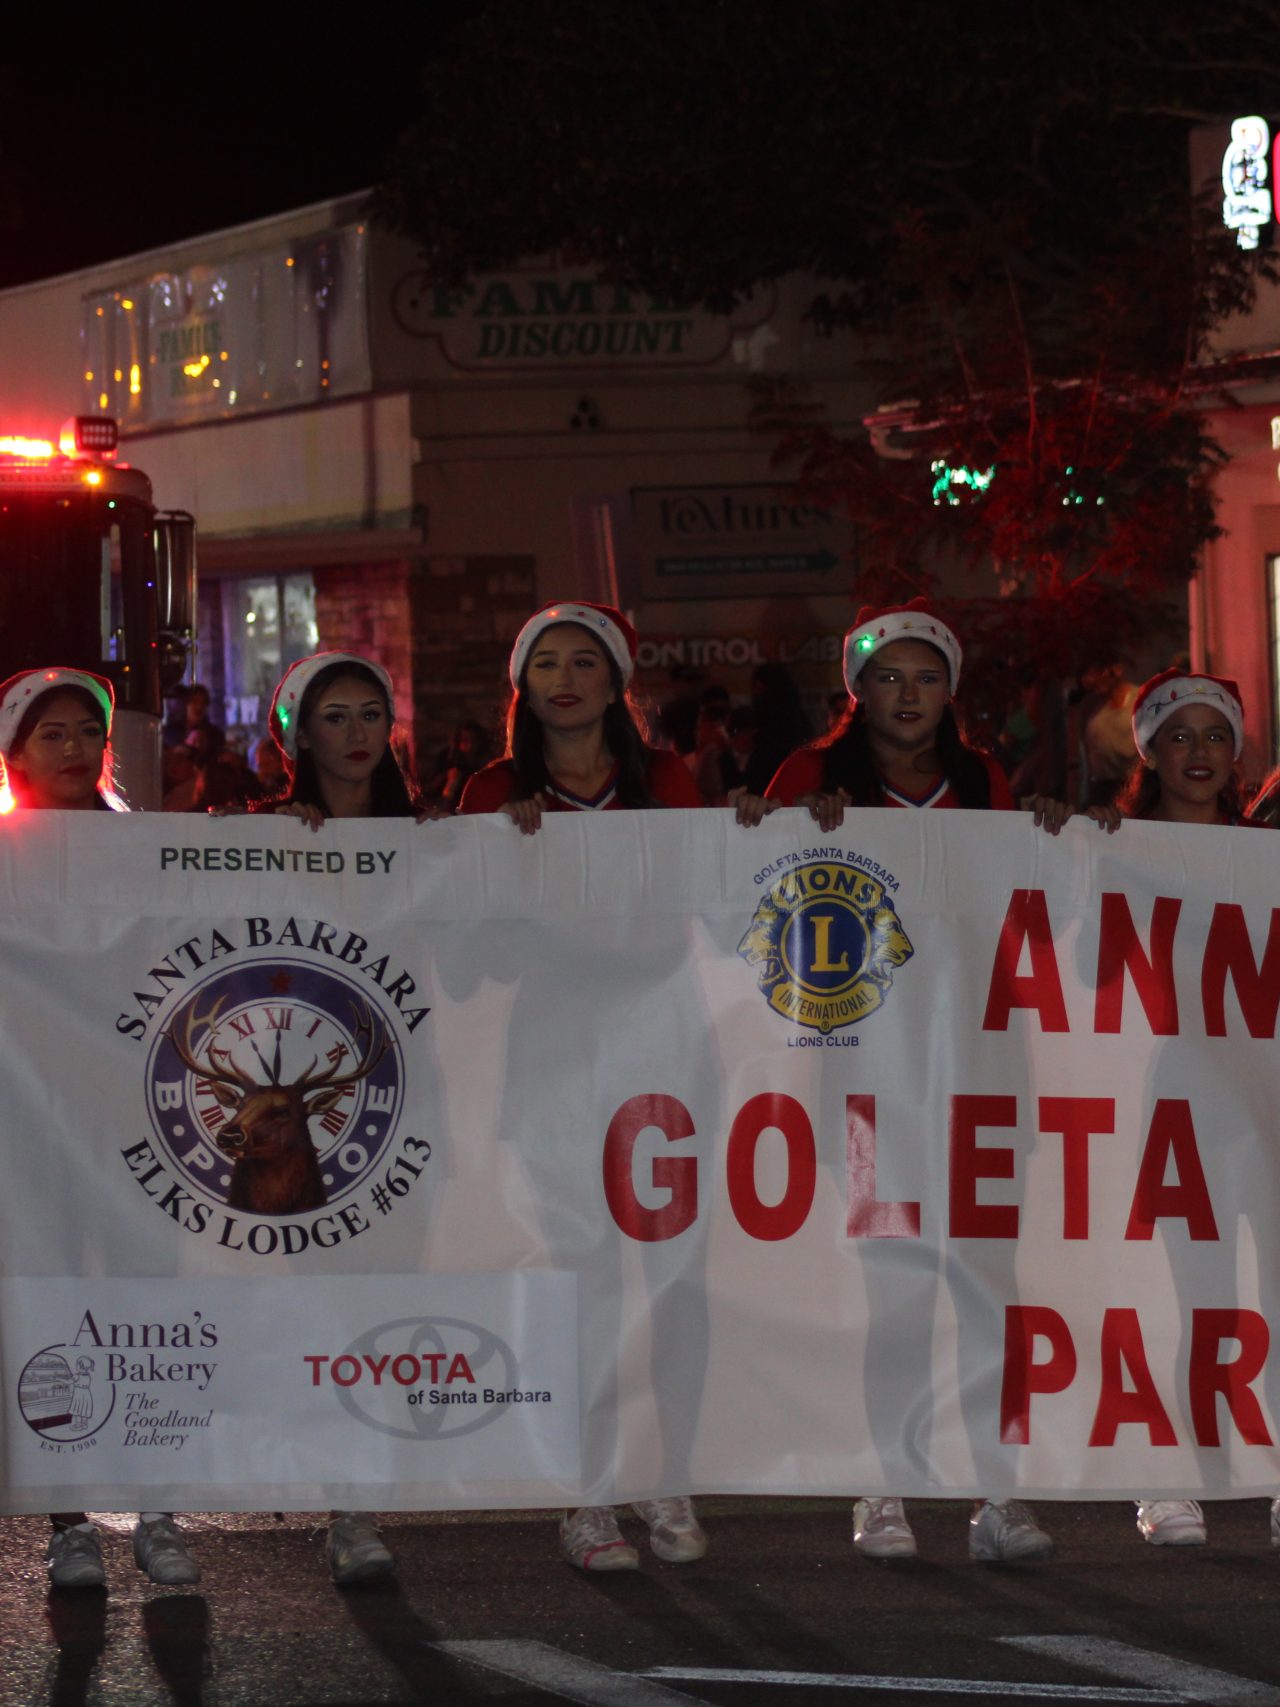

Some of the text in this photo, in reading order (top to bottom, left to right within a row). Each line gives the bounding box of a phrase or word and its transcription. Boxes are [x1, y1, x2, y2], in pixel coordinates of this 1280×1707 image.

[478, 320, 693, 358] DISCOUNT
[160, 847, 396, 874] PRESENTED BY
[753, 847, 900, 893] GOLETA SANTA BARBARA
[779, 868, 876, 906] LIONS
[809, 916, 849, 972] L
[116, 916, 432, 1042] SANTA BARBARA
[777, 989, 875, 1021] INTERNATIONAL
[787, 1036, 860, 1048] LIONS CLUB
[602, 1092, 1221, 1243] GOLETA
[120, 1135, 433, 1257] ELKS LODGE #613
[69, 1308, 220, 1349] Anna's
[105, 1353, 219, 1391] Bakery
[303, 1353, 477, 1389] TOYOTA
[124, 1392, 160, 1411] The
[407, 1387, 552, 1405] of Santa Barbara
[124, 1410, 213, 1430] Goodland
[123, 1429, 190, 1450] Bakery
